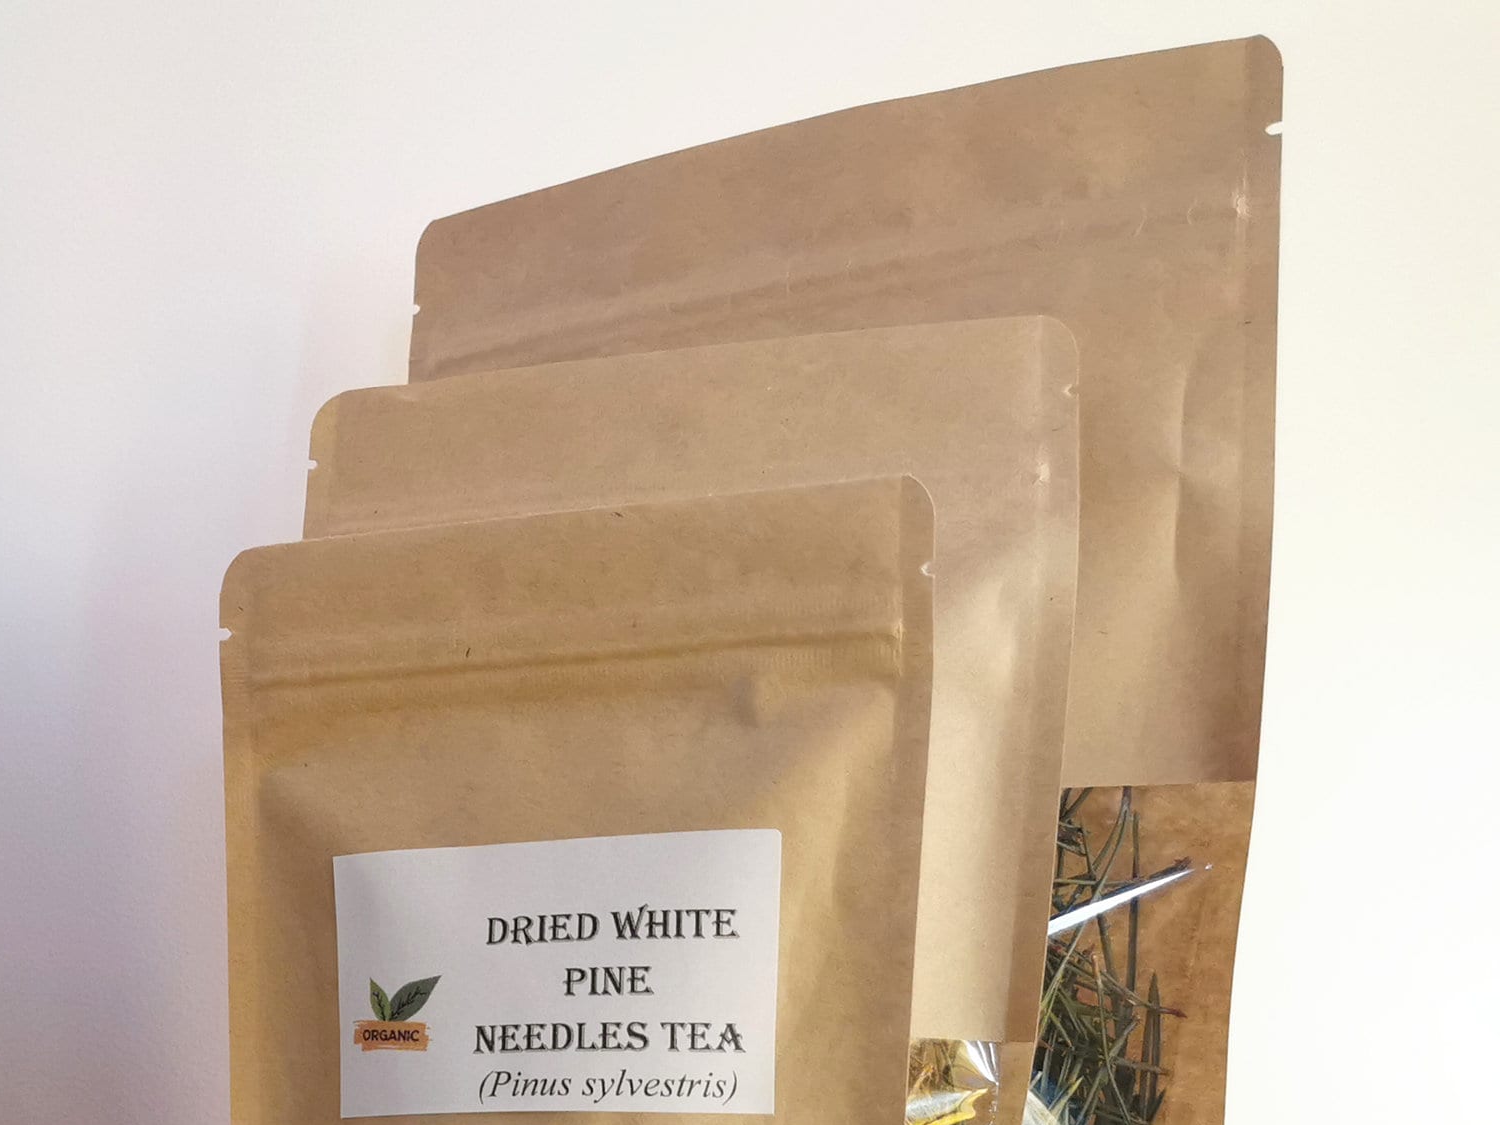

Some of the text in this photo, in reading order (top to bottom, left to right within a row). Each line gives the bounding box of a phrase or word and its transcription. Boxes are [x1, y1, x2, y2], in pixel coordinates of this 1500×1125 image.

[485, 904, 740, 946] DRIED WHITE
[563, 965, 654, 997] PINE
[362, 1028, 420, 1044] ORGANIC
[472, 1021, 746, 1054] NEEDLES TEA
[478, 1068, 739, 1105] (Pinus sylvestris)
